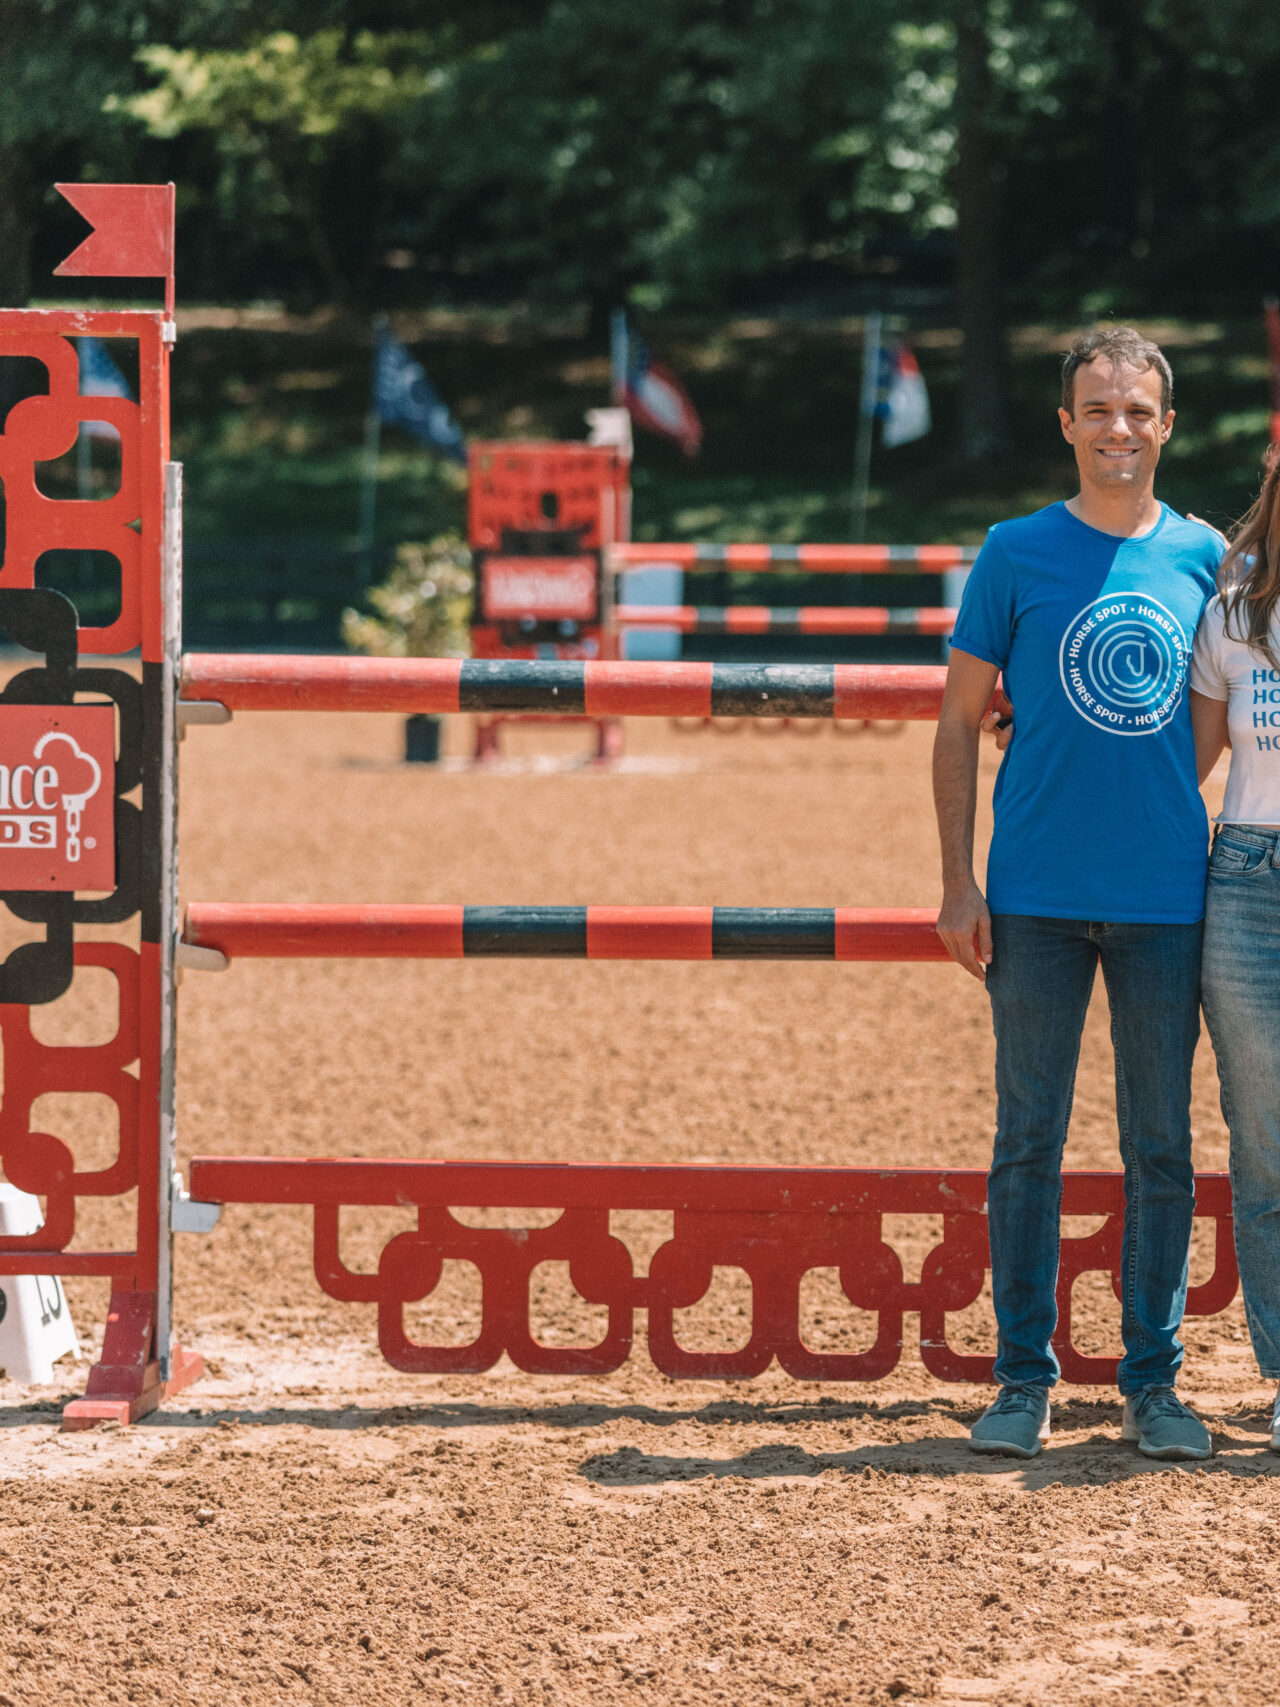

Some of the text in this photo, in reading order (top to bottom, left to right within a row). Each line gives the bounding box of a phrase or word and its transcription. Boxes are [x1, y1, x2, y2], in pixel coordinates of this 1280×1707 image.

[1068, 603, 1127, 658] HORSE SPOT
[1138, 604, 1184, 667] HORSE SPOT
[1069, 667, 1126, 725] HORSE SPOT
[1135, 675, 1183, 726] HORSE SPOT
